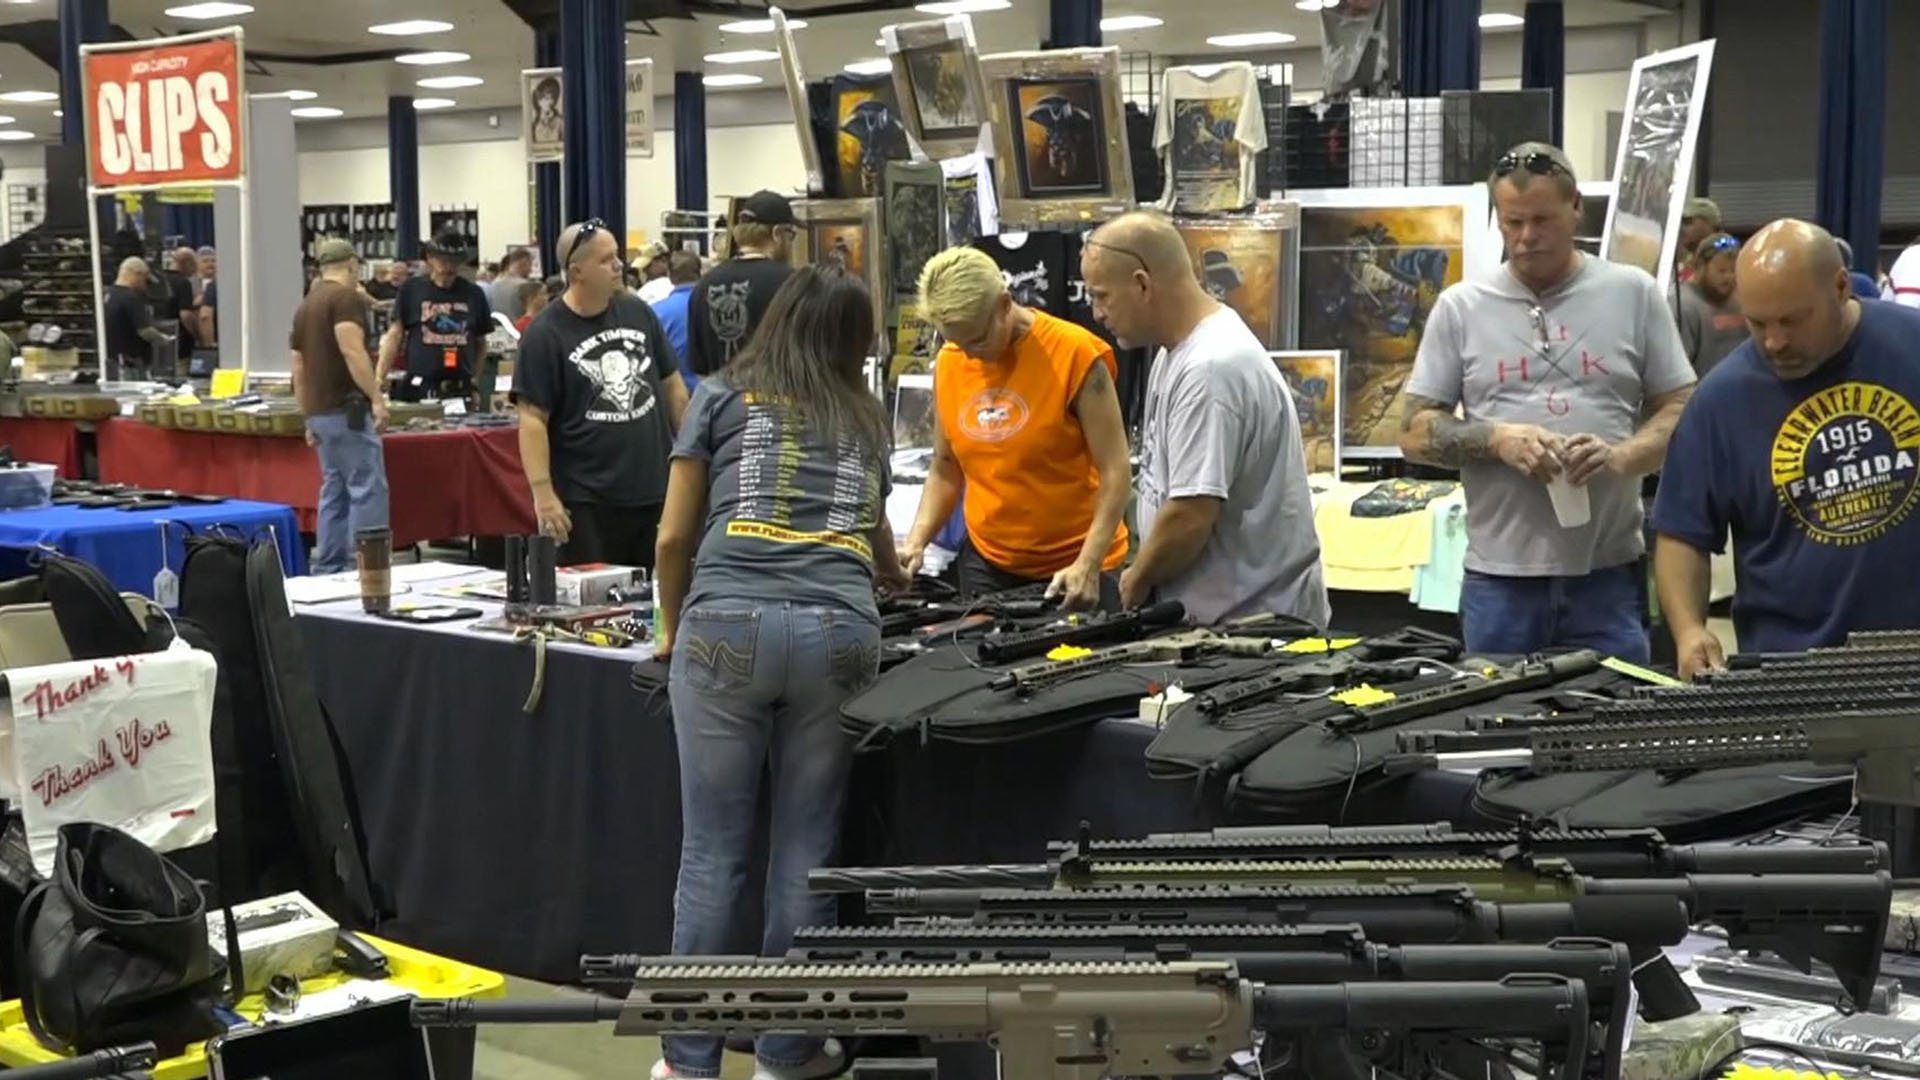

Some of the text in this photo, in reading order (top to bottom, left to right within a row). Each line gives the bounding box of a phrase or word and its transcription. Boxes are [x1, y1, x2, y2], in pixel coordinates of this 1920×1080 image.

[98, 71, 232, 175] CLIPS
[568, 335, 600, 364] DARK
[585, 409, 629, 422] CUSTOM
[1774, 386, 1861, 476] CLEARWATER
[1816, 419, 1873, 454] 1915
[1790, 450, 1914, 499] FLORIDA
[1820, 492, 1892, 521] AUTHENTIC
[23, 664, 109, 720] Thank
[31, 717, 172, 806] Thank You
